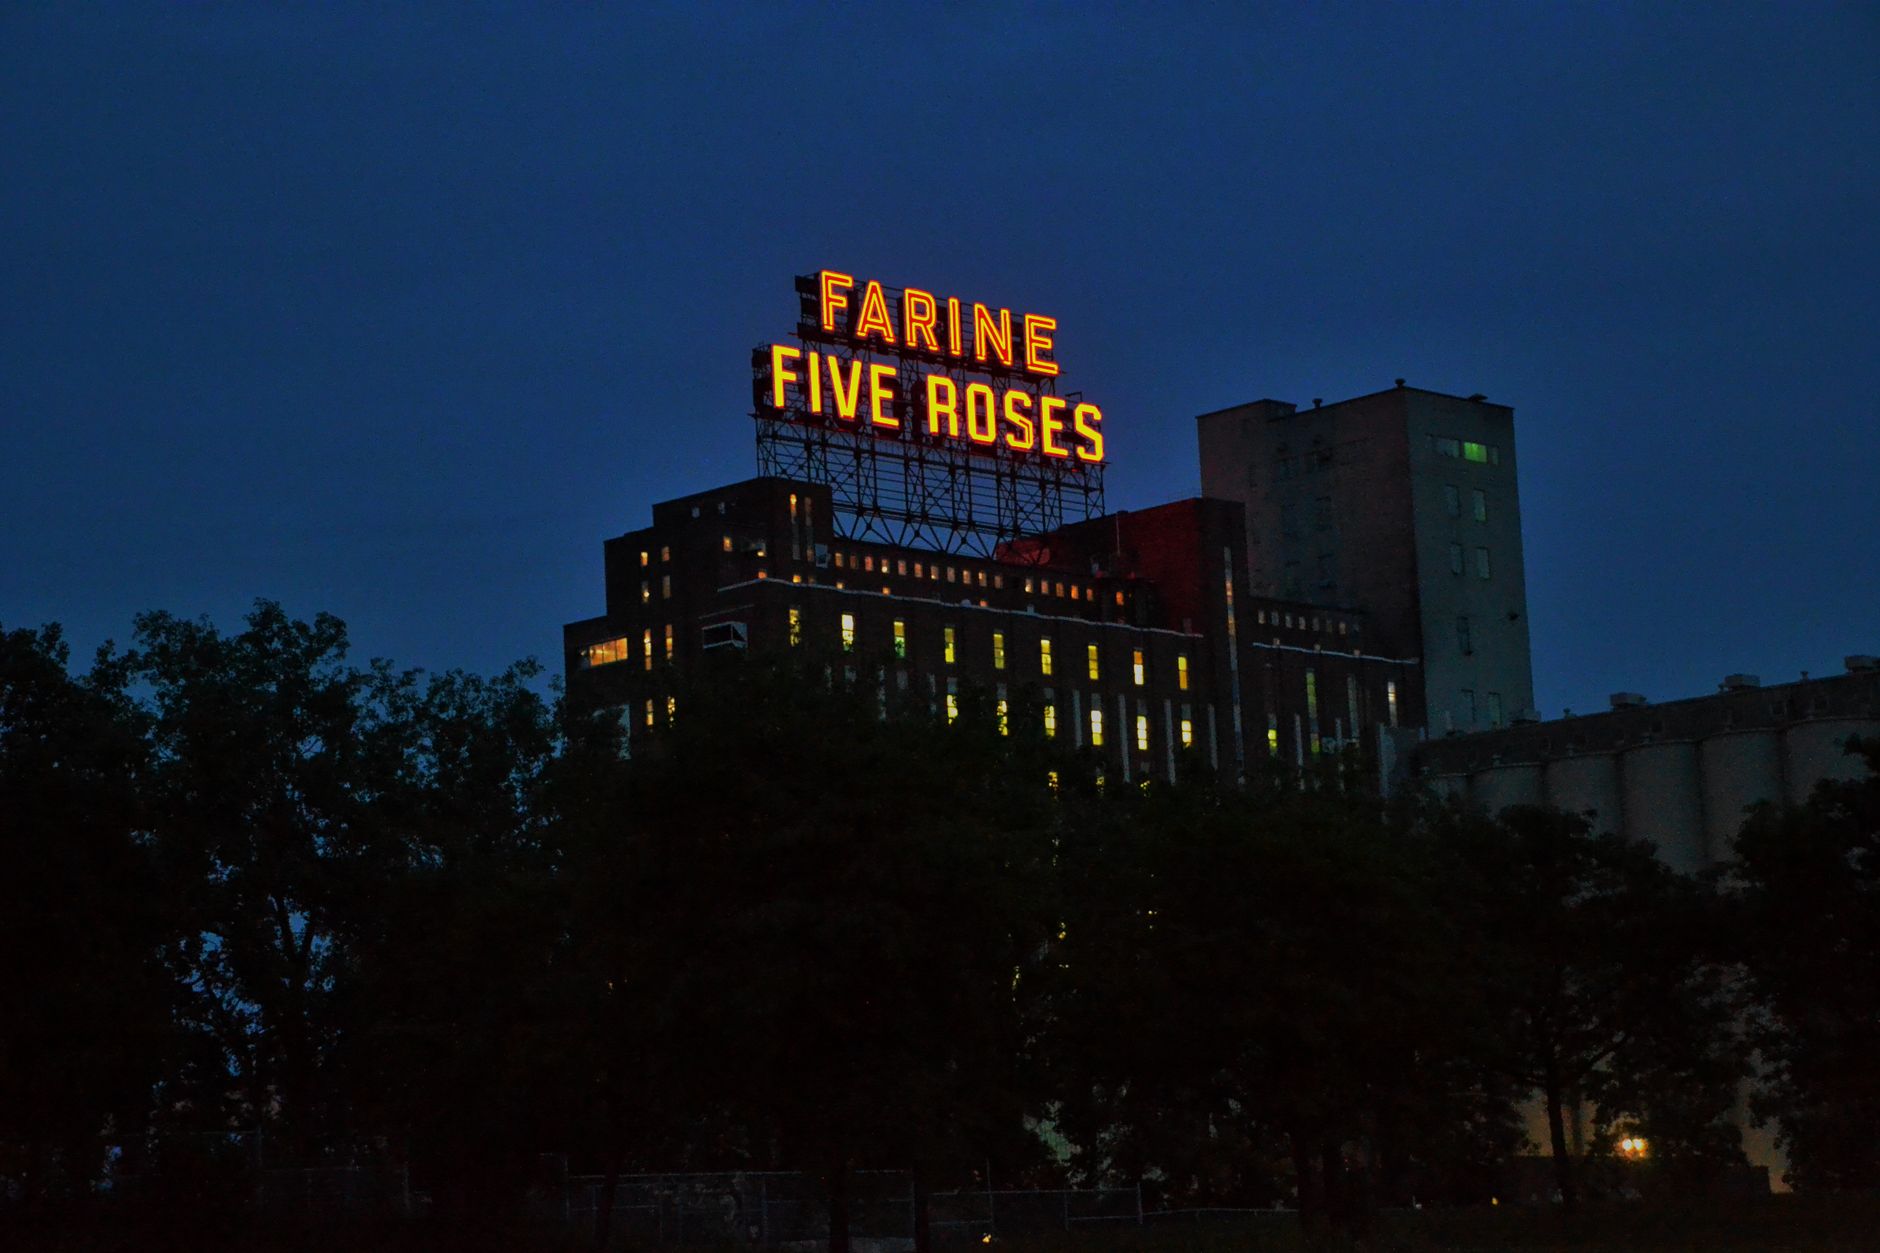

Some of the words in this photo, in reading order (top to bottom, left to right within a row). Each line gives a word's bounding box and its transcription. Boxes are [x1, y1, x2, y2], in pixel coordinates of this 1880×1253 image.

[821, 270, 1060, 375] FARINE
[771, 344, 900, 429] FIVE
[926, 374, 1104, 463] ROSES
